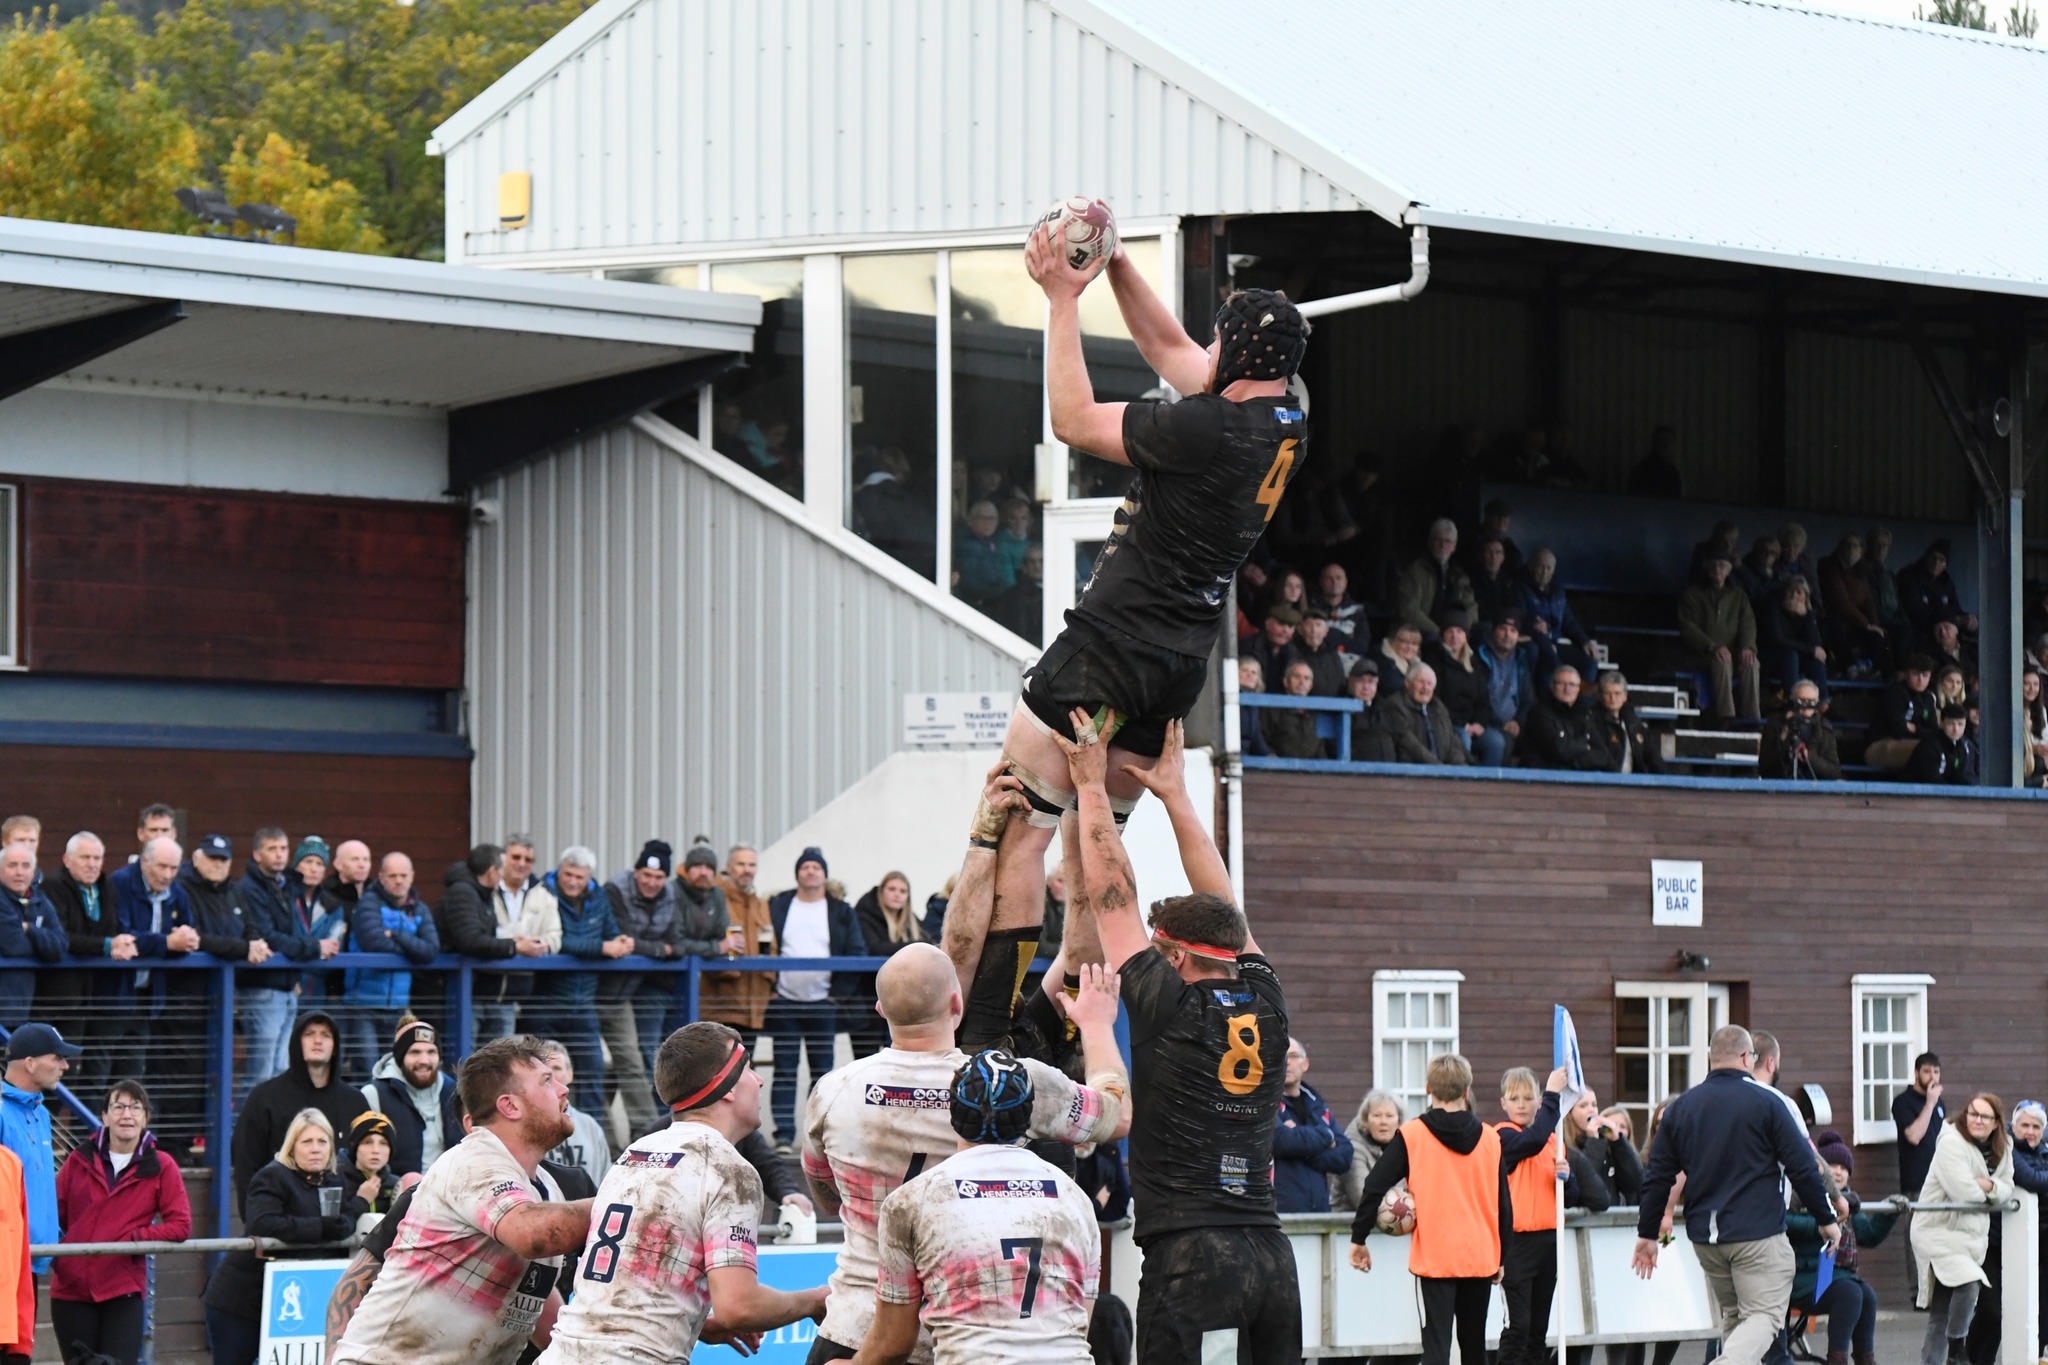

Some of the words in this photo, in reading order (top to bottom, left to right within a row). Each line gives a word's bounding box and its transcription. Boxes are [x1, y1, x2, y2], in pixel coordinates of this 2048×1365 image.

[1255, 438, 1299, 522] 4
[963, 712, 1008, 720] TRANSFER
[966, 721, 977, 729] TO
[979, 721, 1007, 729] STAND
[1657, 878, 1697, 893] PUBLIC
[1666, 896, 1689, 911] BAR
[1218, 1013, 1264, 1095] 8
[885, 1091, 912, 1099] ELLIOT
[885, 1098, 951, 1109] HENDERSON
[1067, 1094, 1079, 1119] TINY
[1073, 1087, 1084, 1123] CHAN
[1215, 1102, 1259, 1114] ONDINE
[491, 1180, 513, 1192] TINY
[980, 1190, 1045, 1199] HENDERSON
[730, 1225, 751, 1236] TINY
[583, 1203, 633, 1283] 8
[1000, 1237, 1044, 1319] 7
[508, 1294, 545, 1313] ALLI
[267, 1342, 322, 1365] ALLI
